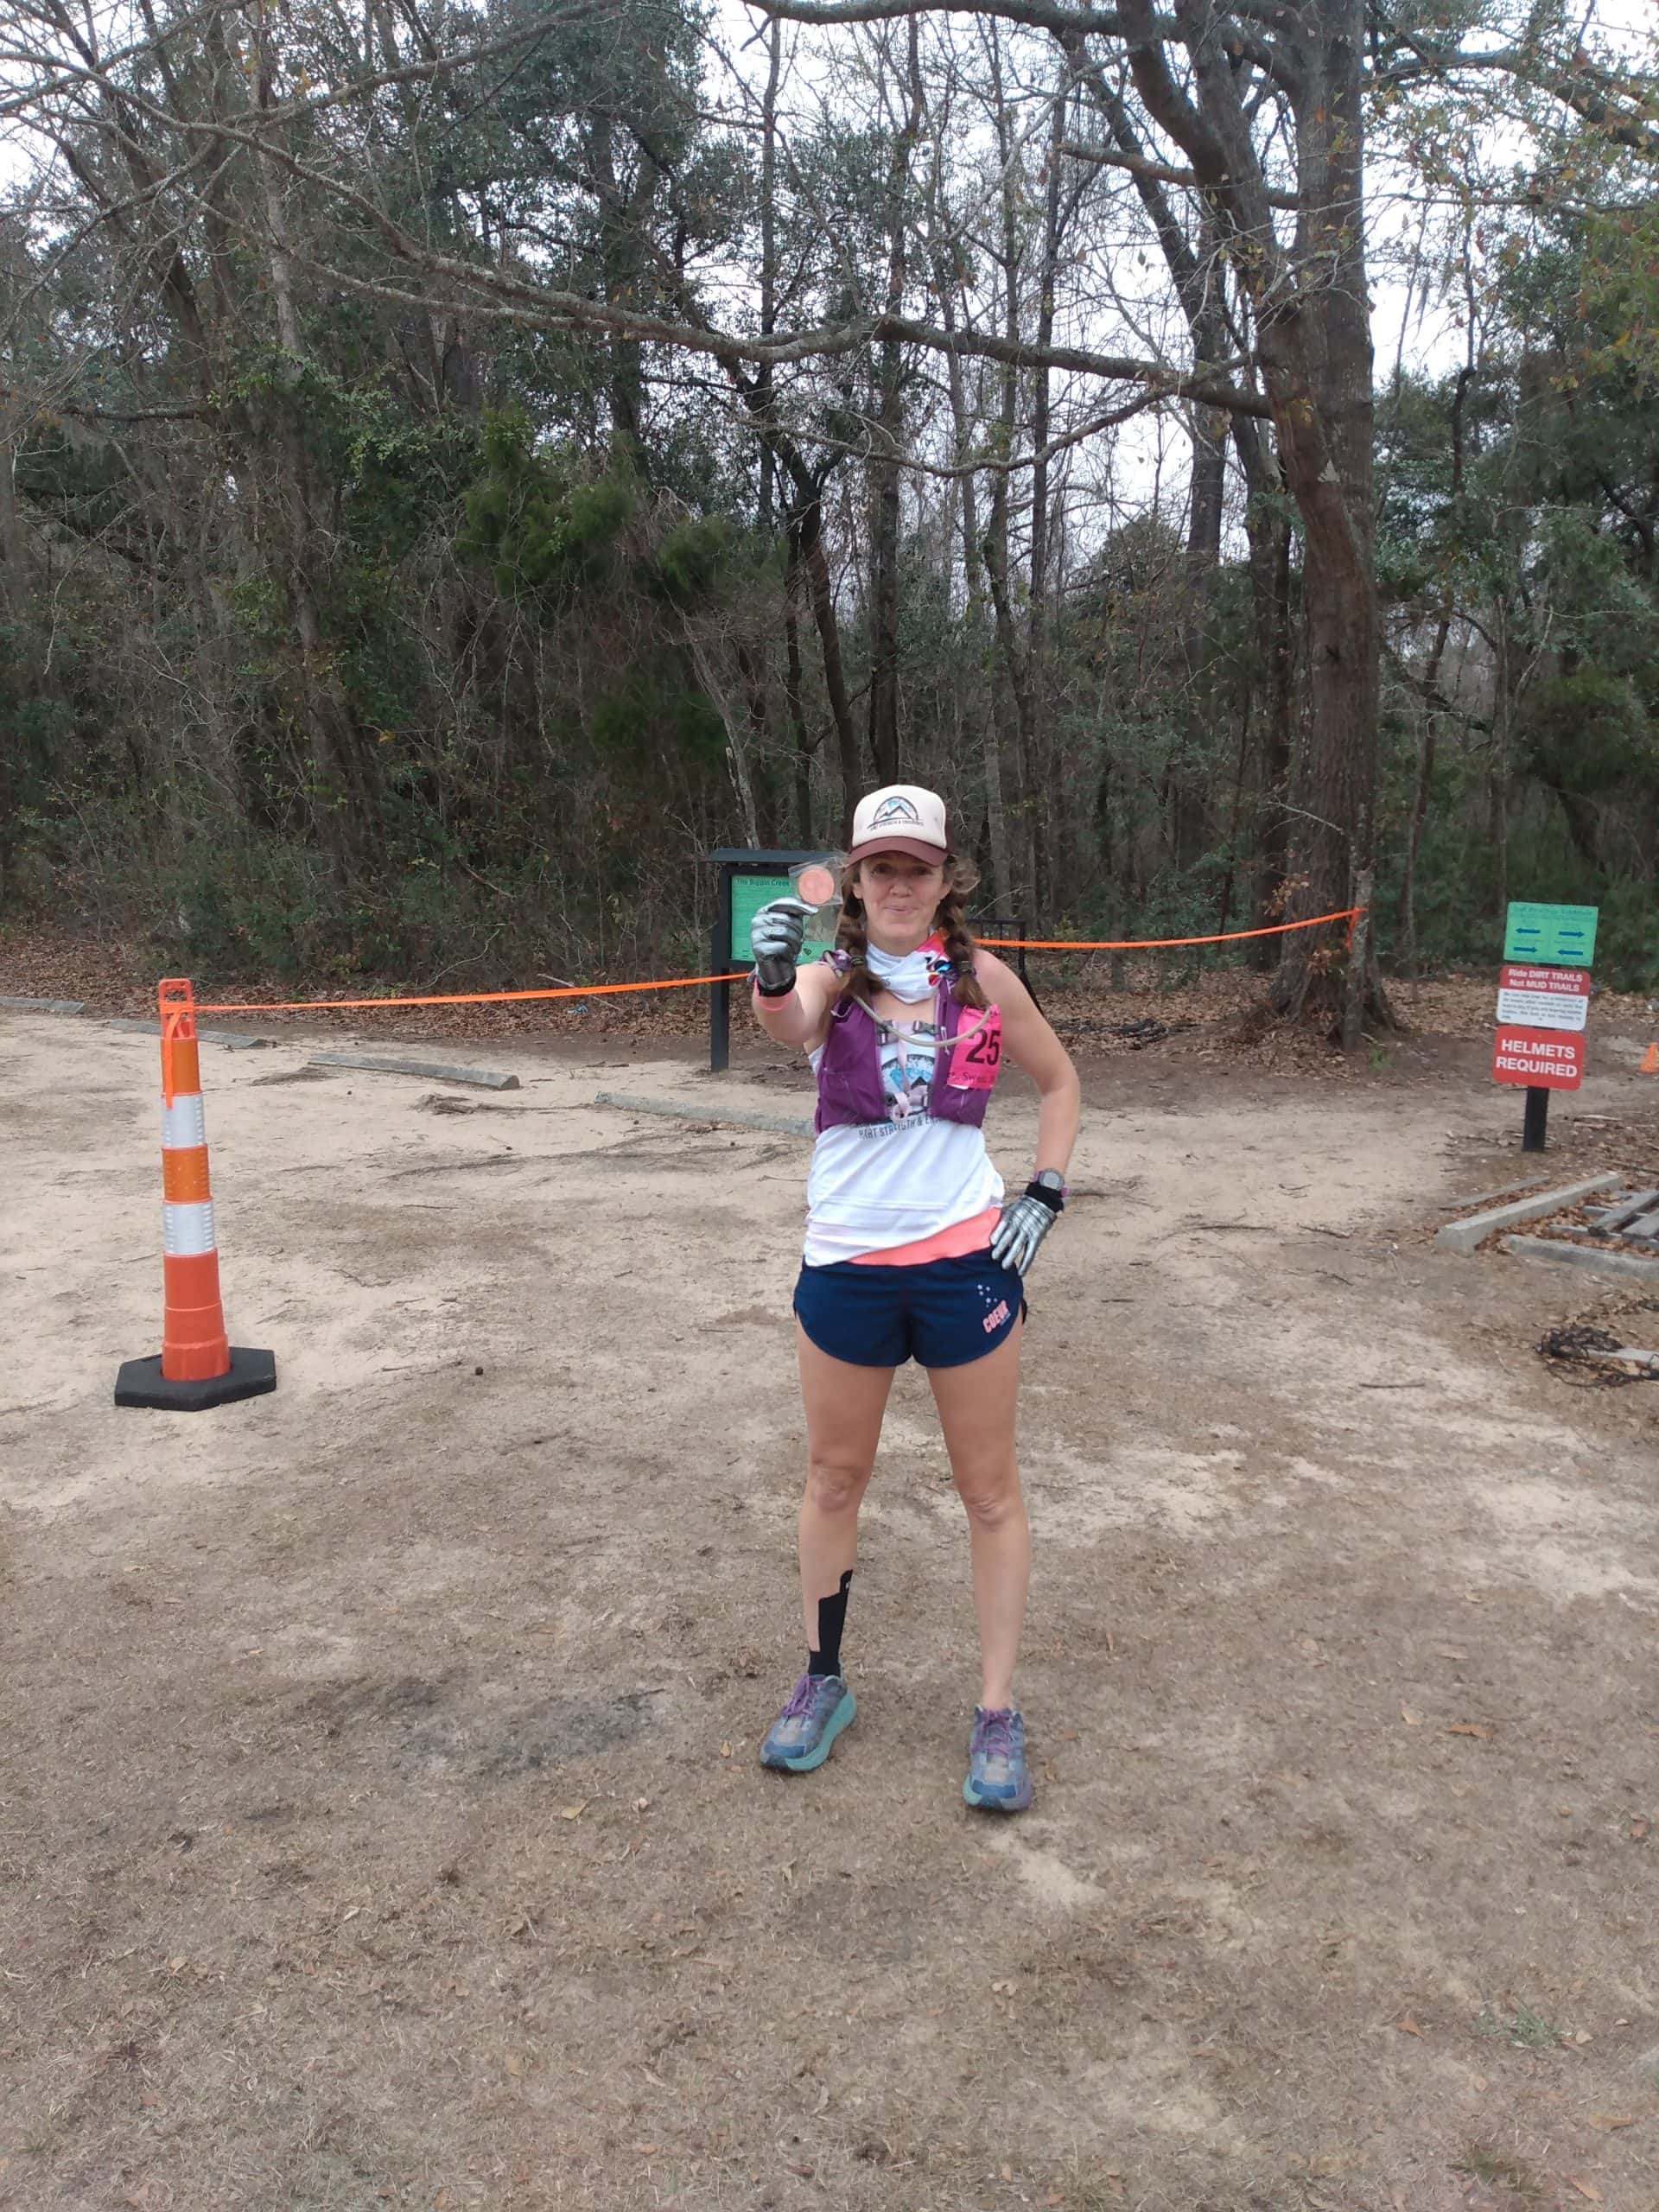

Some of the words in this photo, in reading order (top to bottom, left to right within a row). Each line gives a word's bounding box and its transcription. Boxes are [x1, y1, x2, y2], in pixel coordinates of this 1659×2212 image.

[1509, 969, 1528, 978] Ride
[1529, 970, 1549, 980] DIRT
[1552, 972, 1583, 982] TRAILS
[1510, 979, 1525, 988] Not
[1527, 980, 1548, 989] MUD
[1548, 982, 1580, 992] TRAILS
[966, 1029, 1001, 1065] 25
[1502, 1039, 1575, 1059] HELMETS
[1496, 1056, 1578, 1078] REQUIRED
